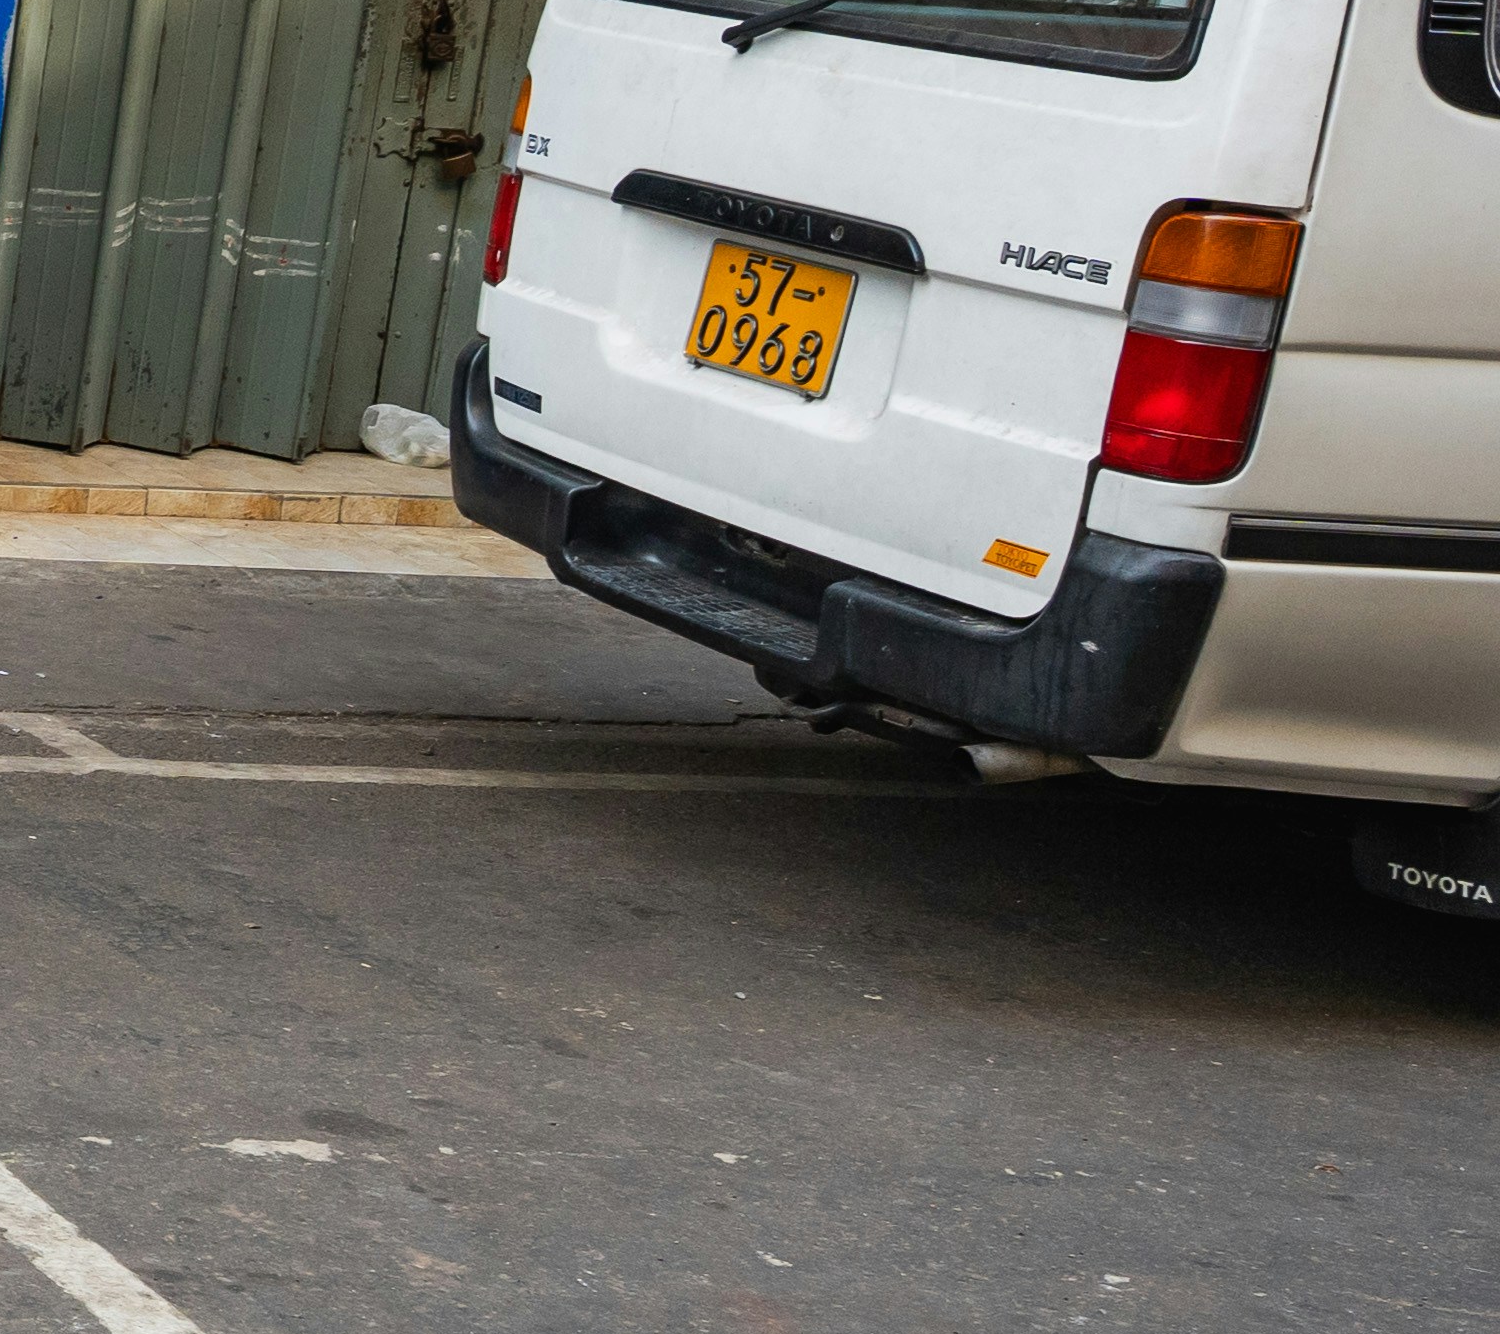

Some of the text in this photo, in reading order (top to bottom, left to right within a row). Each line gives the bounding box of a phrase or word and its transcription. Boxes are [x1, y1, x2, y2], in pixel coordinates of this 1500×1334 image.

[525, 133, 551, 157] DX
[700, 190, 813, 240] TOYOTA
[1000, 241, 1112, 285] HIACE
[696, 305, 823, 385] 0968
[1387, 862, 1494, 904] TOYOTA
